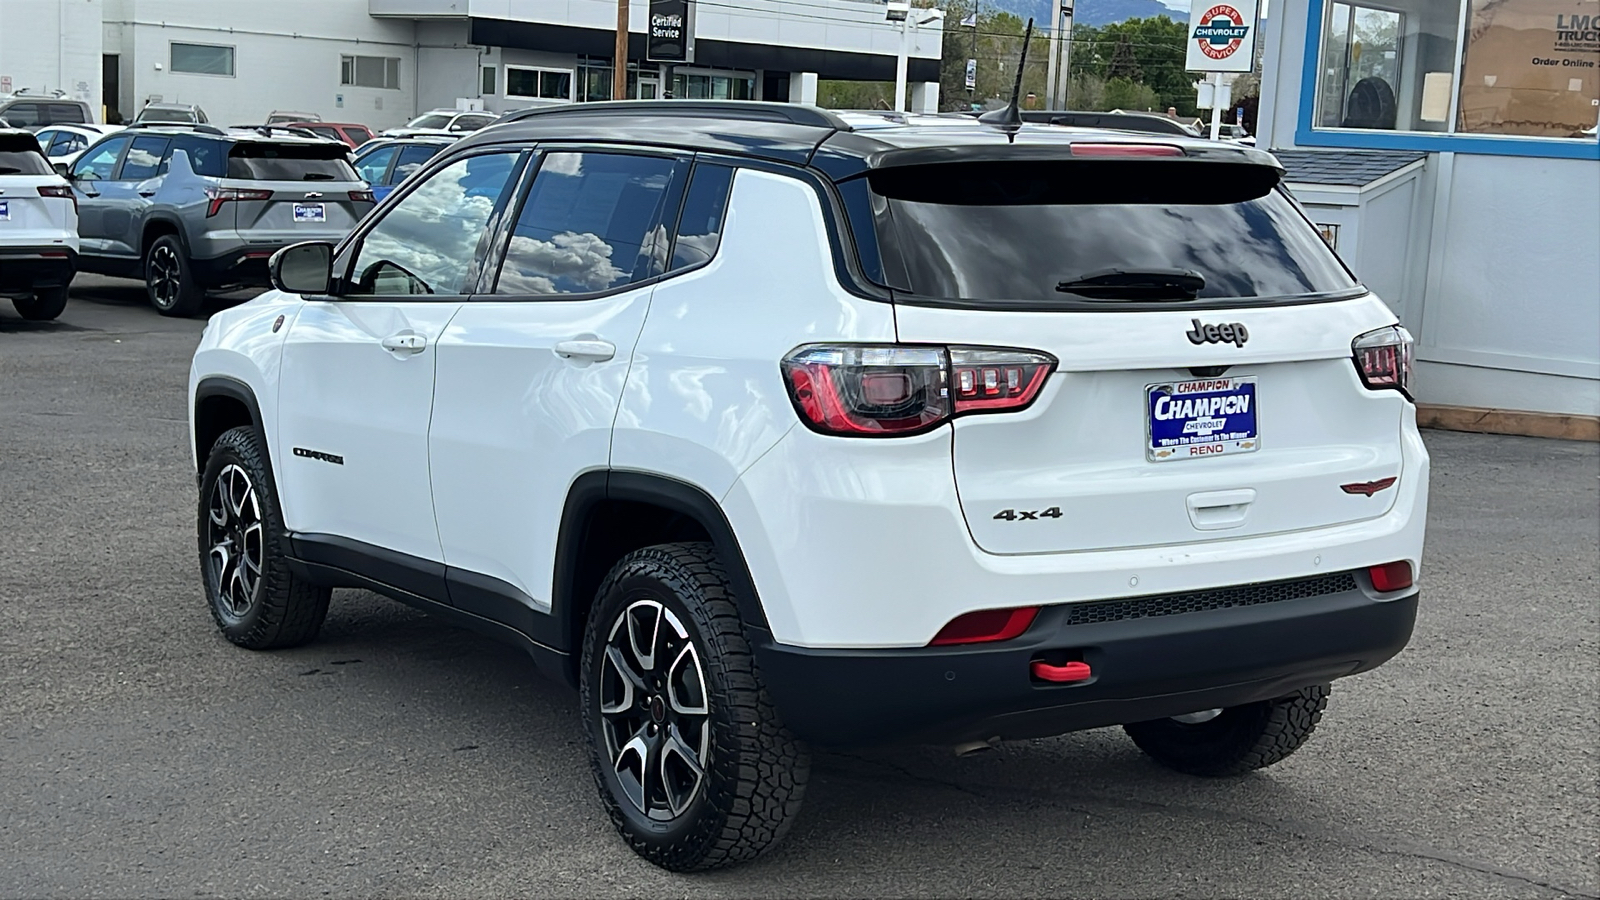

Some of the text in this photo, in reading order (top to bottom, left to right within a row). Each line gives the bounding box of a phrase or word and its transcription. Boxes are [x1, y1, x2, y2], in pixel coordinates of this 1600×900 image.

[1205, 6, 1238, 20] SUPER
[652, 15, 682, 27] Certified
[653, 27, 680, 38] Service
[1196, 28, 1245, 36] CHEVROLET
[1200, 41, 1238, 58] SERVICE
[1532, 57, 1594, 68] Order Online
[1185, 318, 1249, 348] Jeep
[1177, 380, 1229, 393] CHAMPION
[1154, 394, 1250, 420] CHAMPION
[1186, 420, 1223, 430] CHEVROLET
[1190, 444, 1224, 456] RENO
[993, 506, 1063, 521] 4x4
